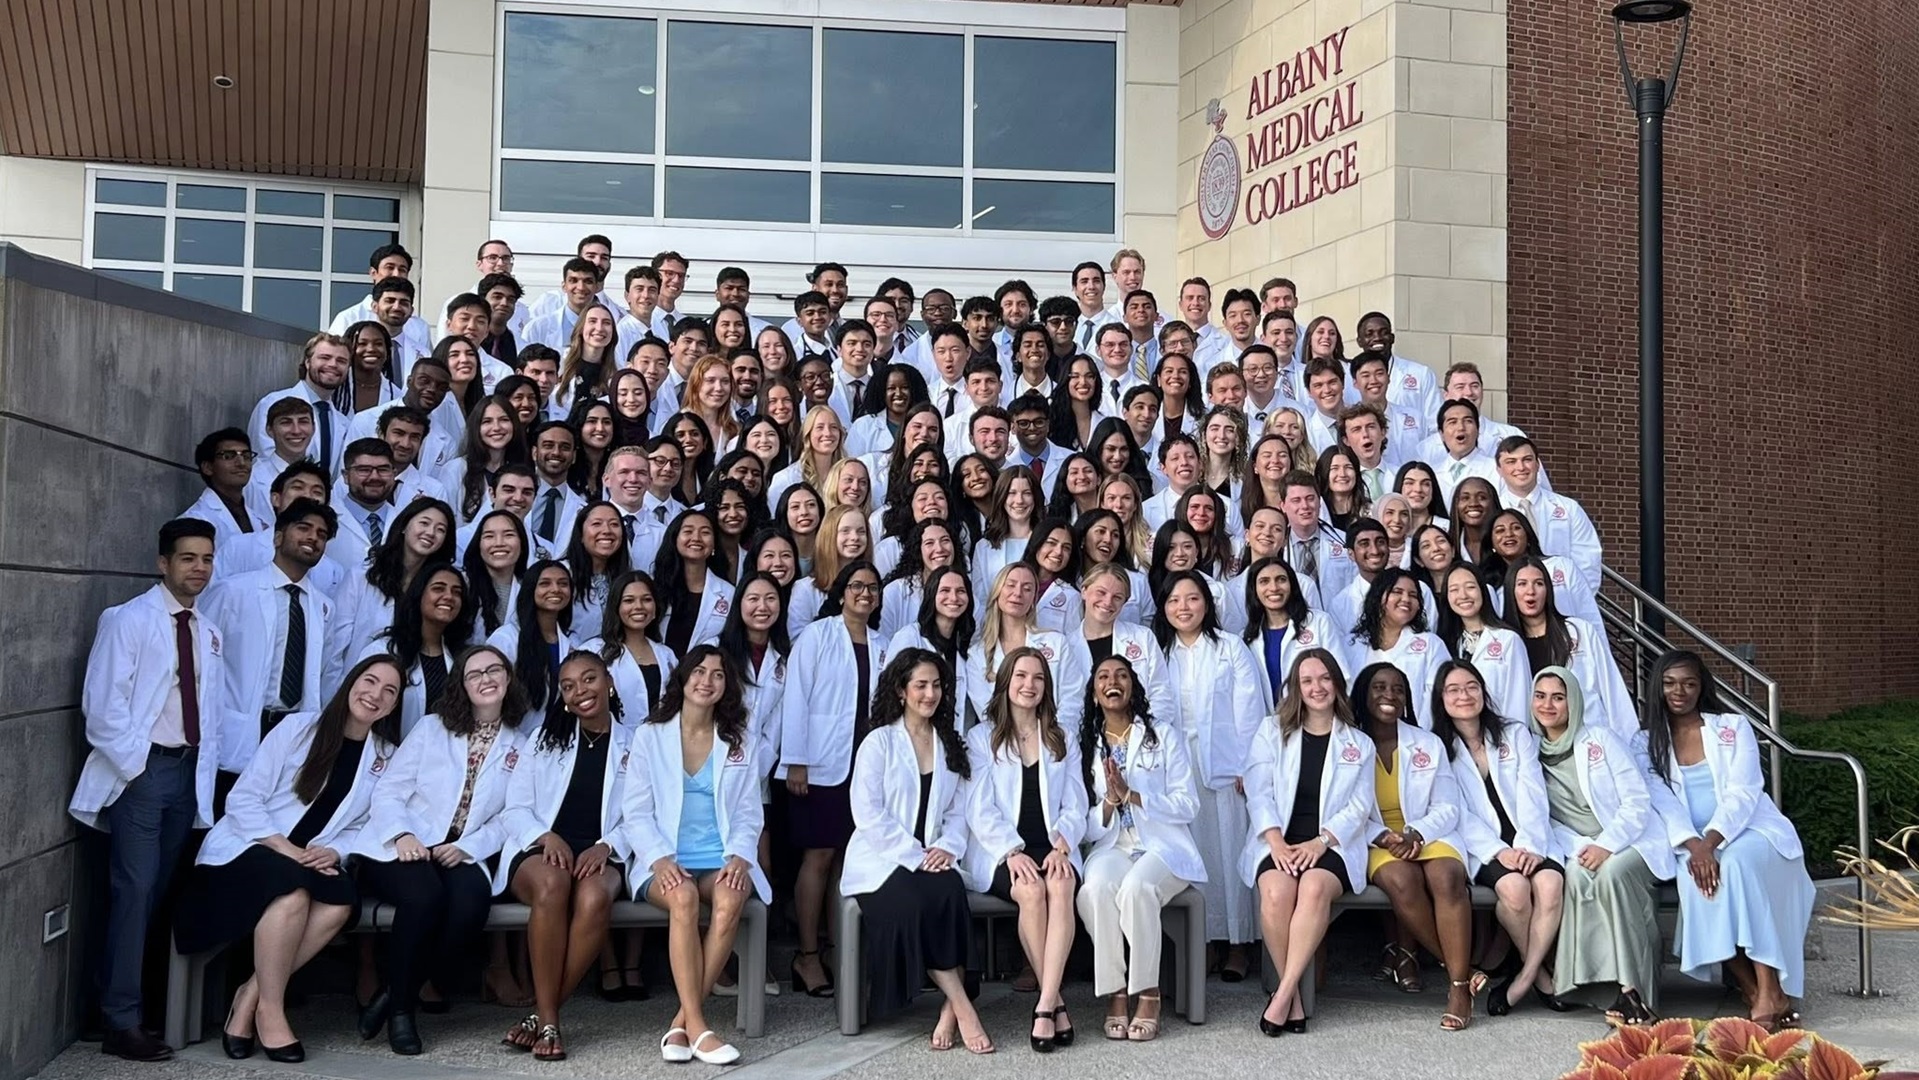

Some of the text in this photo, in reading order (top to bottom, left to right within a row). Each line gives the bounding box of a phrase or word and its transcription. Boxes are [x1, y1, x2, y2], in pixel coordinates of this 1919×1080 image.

[1246, 26, 1349, 120] ALBANY
[1246, 81, 1363, 173] MEDICAL
[1245, 141, 1359, 225] COLLEGE
